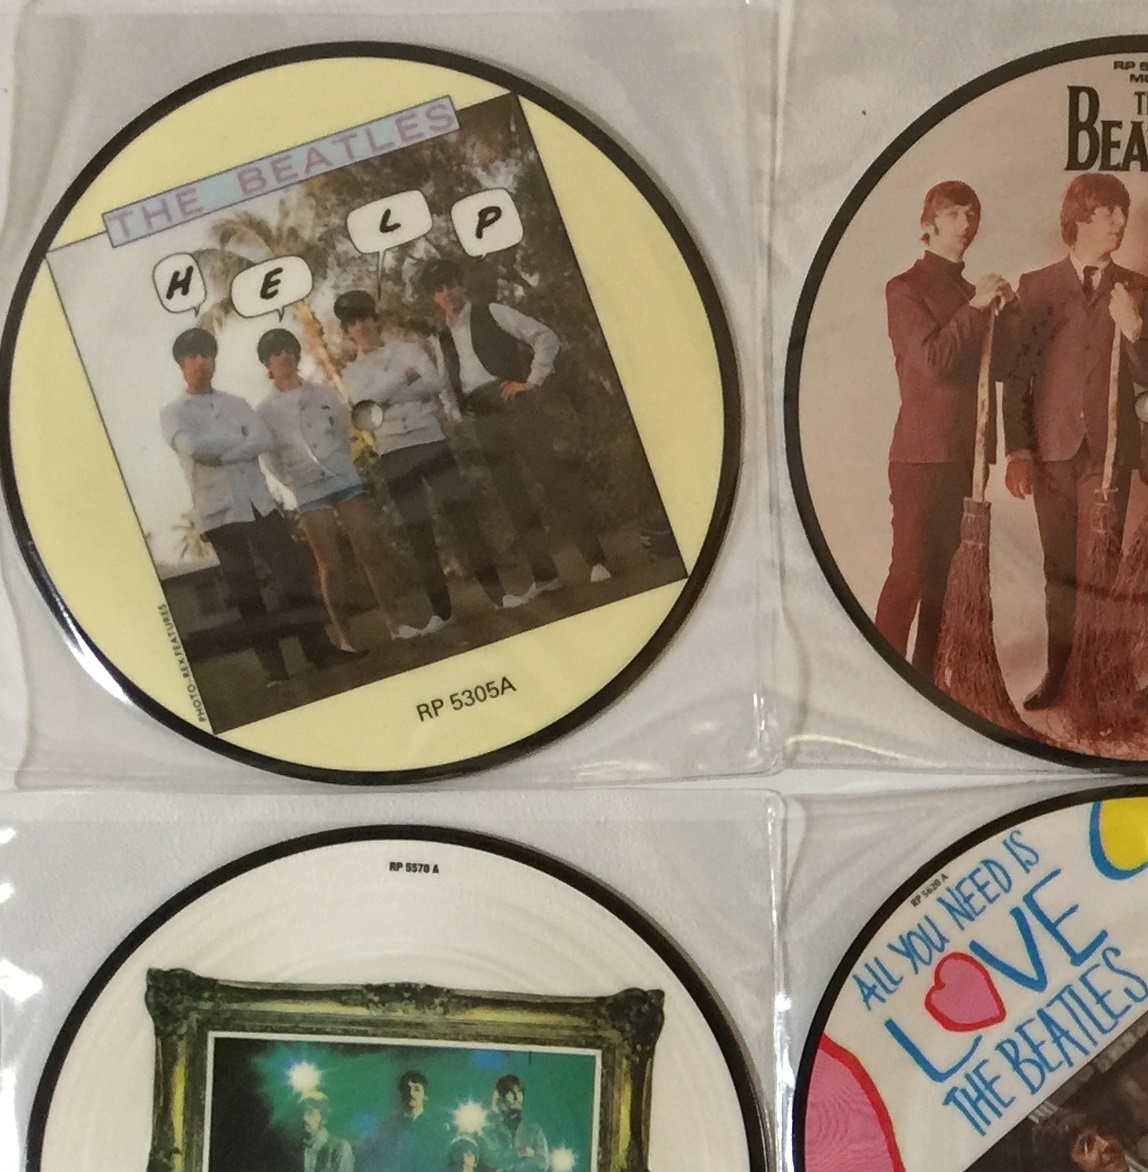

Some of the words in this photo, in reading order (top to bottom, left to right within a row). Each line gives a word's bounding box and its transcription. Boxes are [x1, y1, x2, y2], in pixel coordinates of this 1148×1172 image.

[1113, 61, 1136, 70] RP
[108, 187, 204, 238] THE
[236, 104, 456, 196] BEATLES
[167, 266, 194, 299] H
[260, 267, 283, 299] E
[379, 209, 401, 232] L
[475, 206, 502, 238] P
[158, 603, 182, 656] FEATURES
[416, 699, 444, 722] RP
[449, 676, 517, 711] 5305A
[389, 861, 403, 871] RP
[432, 863, 440, 874] A
[852, 957, 904, 1011] ALL
[887, 915, 950, 975] YOU
[936, 858, 1013, 931] NEED
[1002, 830, 1040, 874] IS
[910, 894, 921, 907] RP
[942, 1059, 1016, 1137] THE
